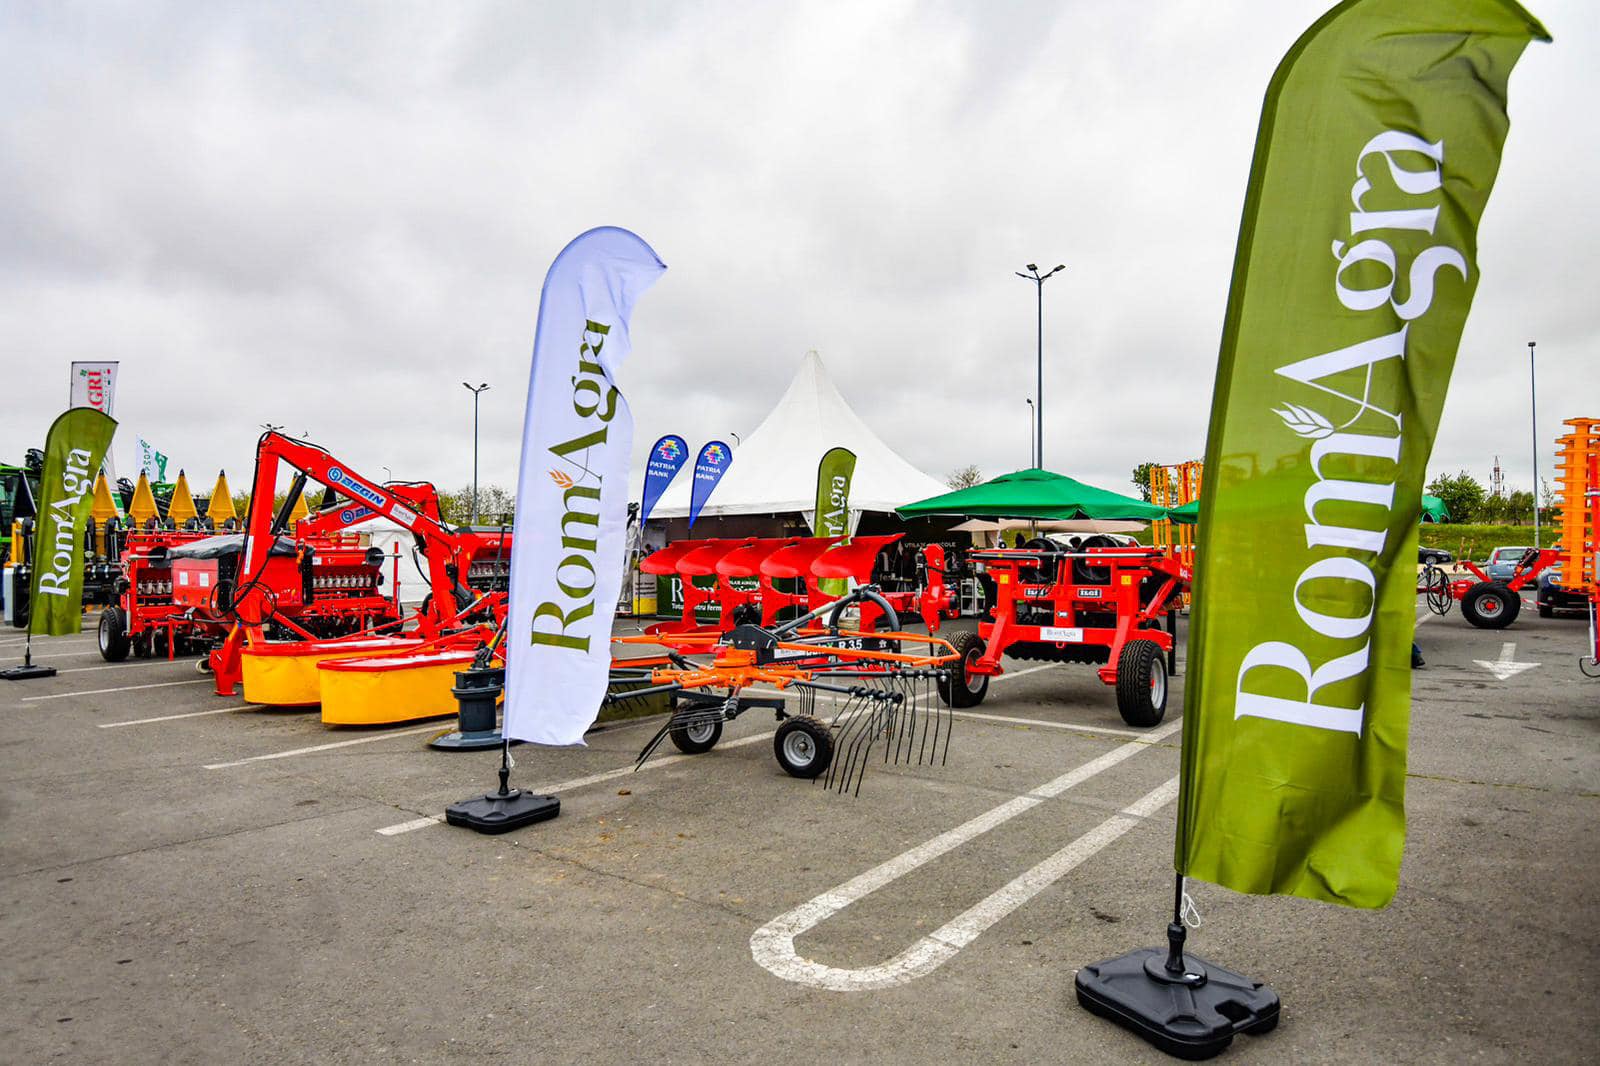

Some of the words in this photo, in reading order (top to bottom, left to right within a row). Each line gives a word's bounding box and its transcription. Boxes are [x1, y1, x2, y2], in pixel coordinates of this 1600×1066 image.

[88, 370, 103, 412] GRI
[1234, 130, 1467, 737] RomAgra
[530, 319, 618, 654] RomAgra
[648, 469, 669, 478] BANK
[650, 461, 676, 470] PATRIA
[695, 473, 715, 481] BANK
[696, 465, 721, 474] PATRIA
[39, 448, 92, 597] RomAgra
[824, 476, 847, 546] mAgra
